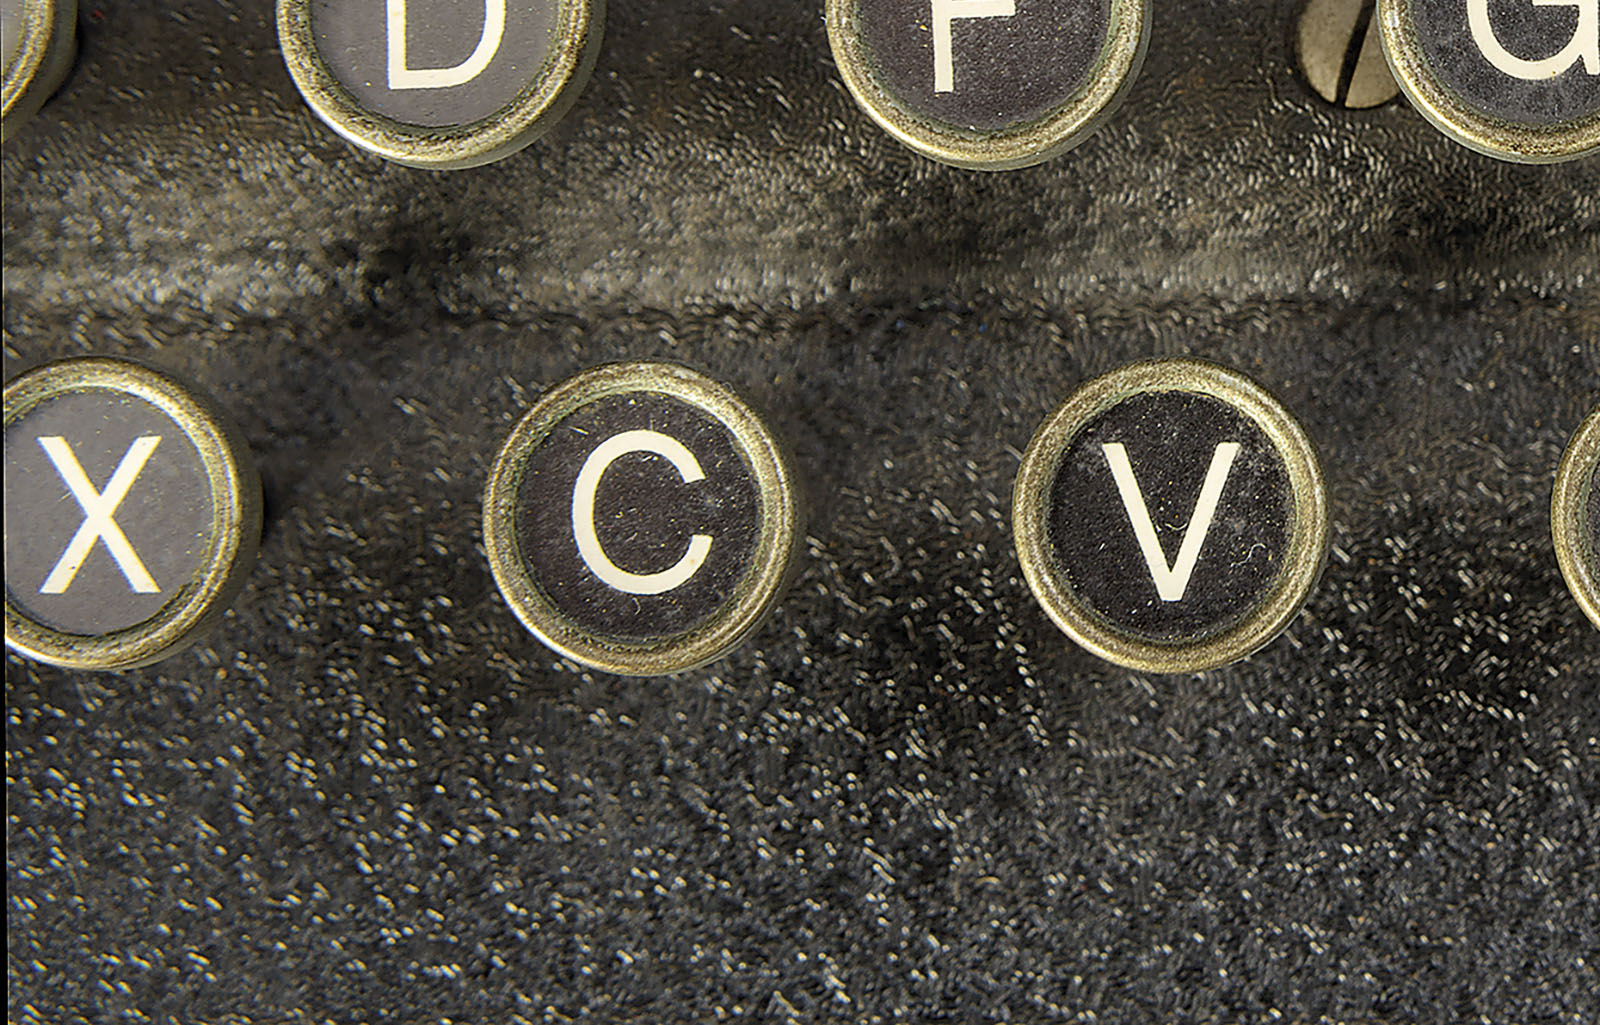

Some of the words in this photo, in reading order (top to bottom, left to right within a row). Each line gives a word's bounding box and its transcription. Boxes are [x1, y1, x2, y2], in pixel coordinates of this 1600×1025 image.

[38, 435, 162, 594] X
[572, 429, 713, 595] C
[1101, 442, 1241, 602] V
